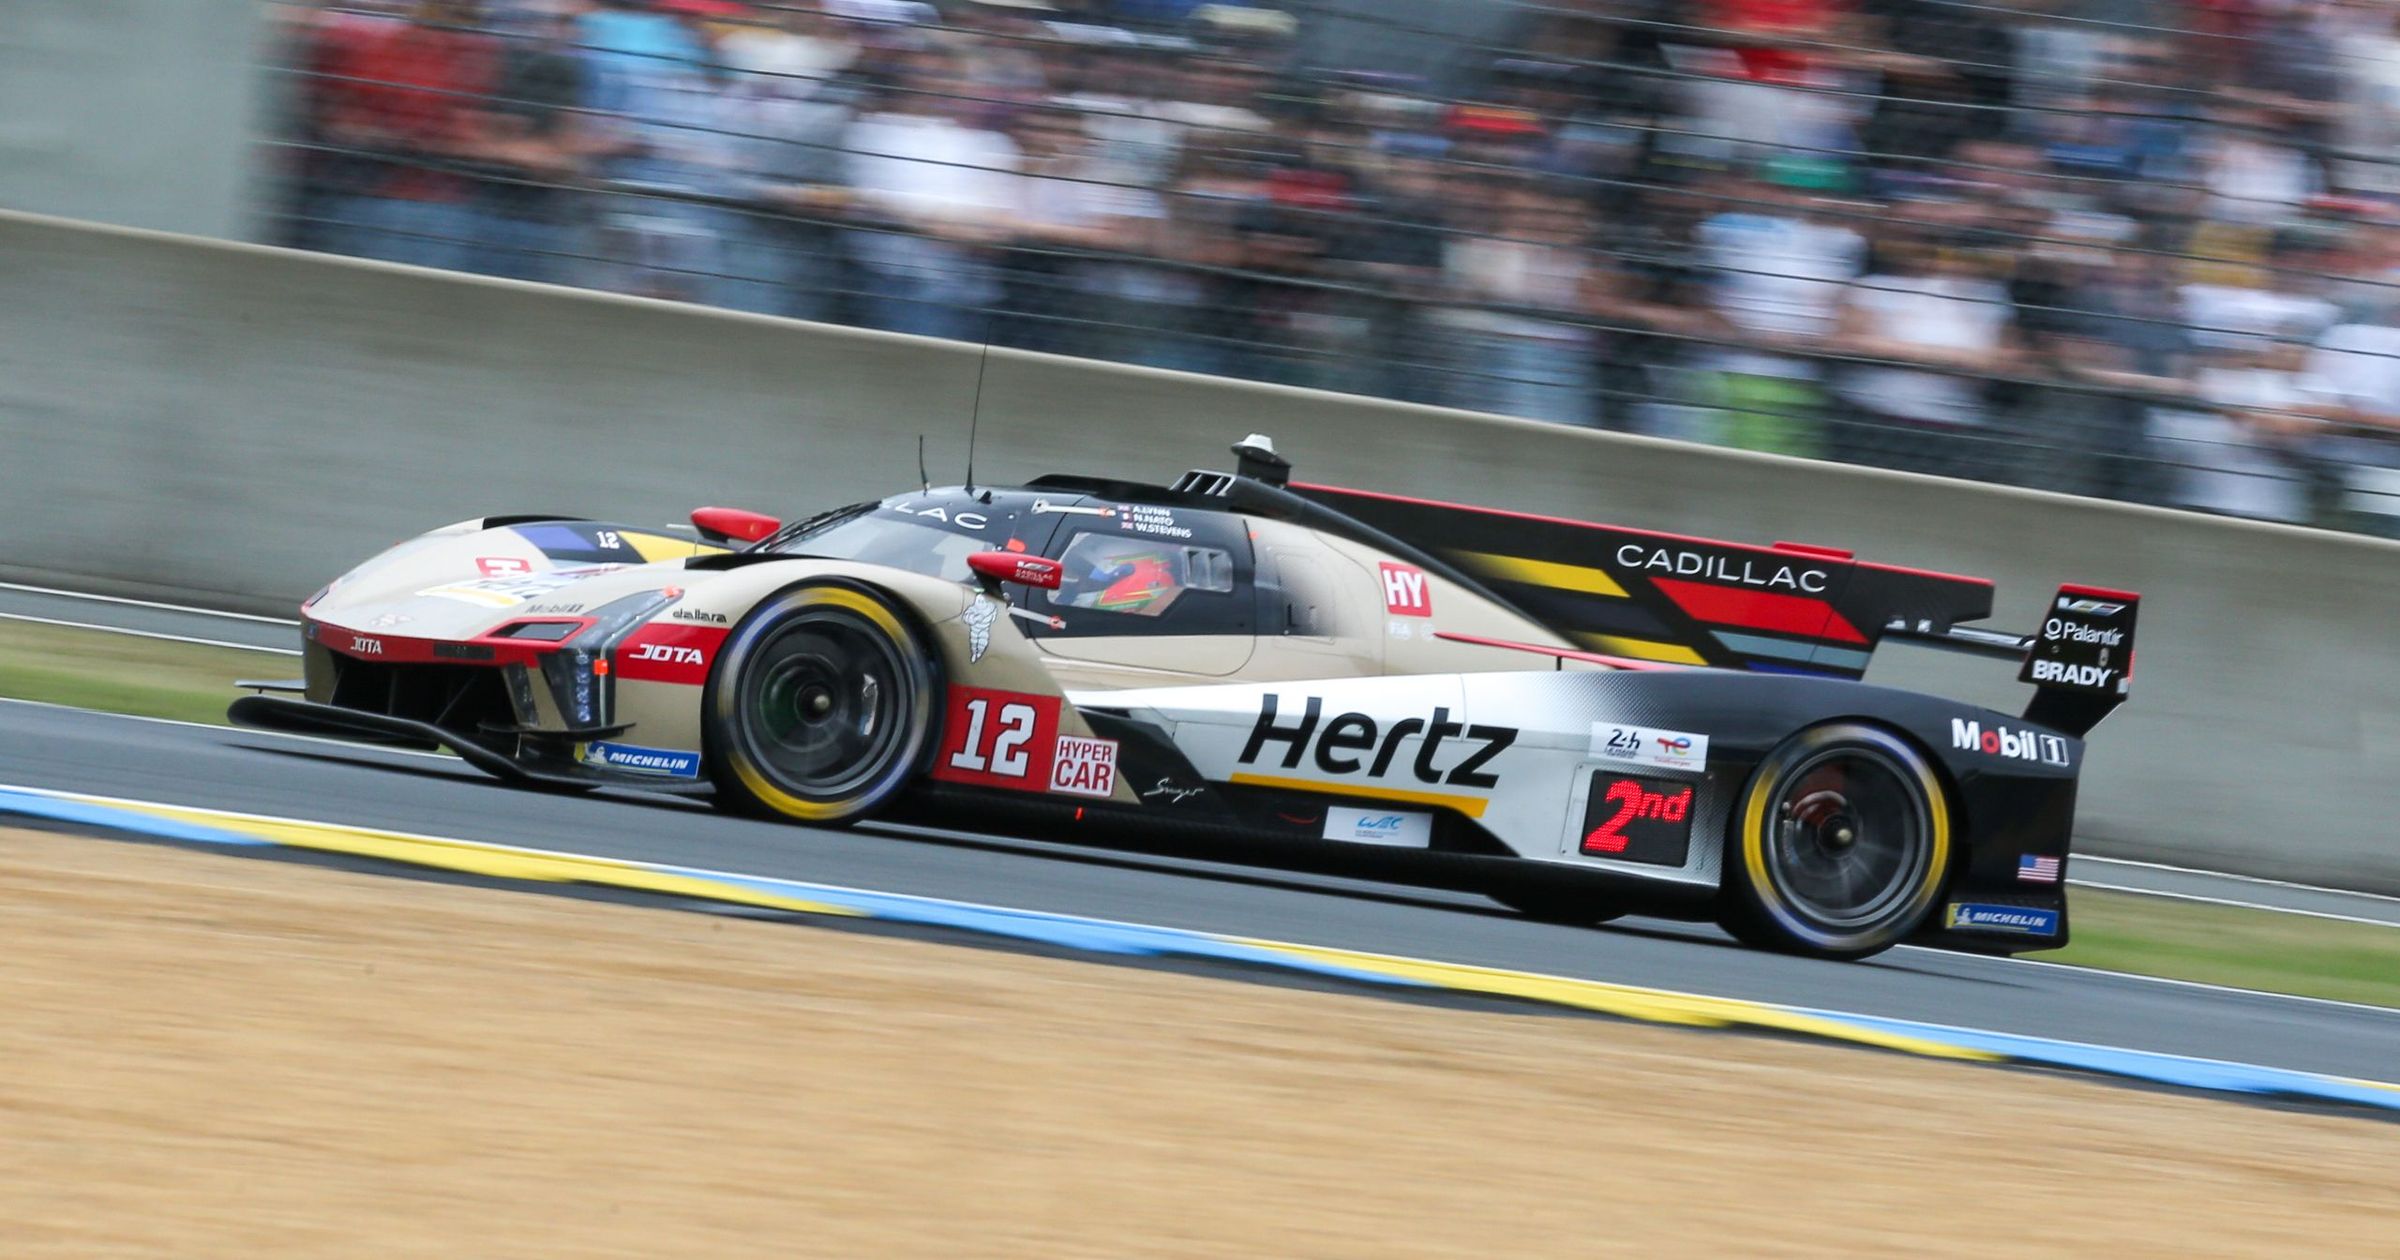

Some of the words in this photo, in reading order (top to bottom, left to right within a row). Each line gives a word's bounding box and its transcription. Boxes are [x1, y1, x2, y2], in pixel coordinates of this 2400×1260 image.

[596, 531, 620, 549] 12
[1616, 544, 1828, 593] CADILLAC
[1382, 569, 1423, 608] HY
[672, 608, 727, 624] dallara
[350, 636, 383, 655] JOTA
[628, 643, 703, 665] JOTA
[2032, 659, 2112, 687] BRADY
[950, 699, 1037, 778] 12
[1059, 739, 1112, 763] HYPER
[1238, 693, 1519, 789] Hertz
[1951, 718, 2038, 761] Mobil
[609, 752, 689, 769] MICHELIN
[1054, 759, 1112, 792] CAR
[1584, 780, 1692, 852] 2nd
[1973, 912, 2048, 927] MICHELIN
